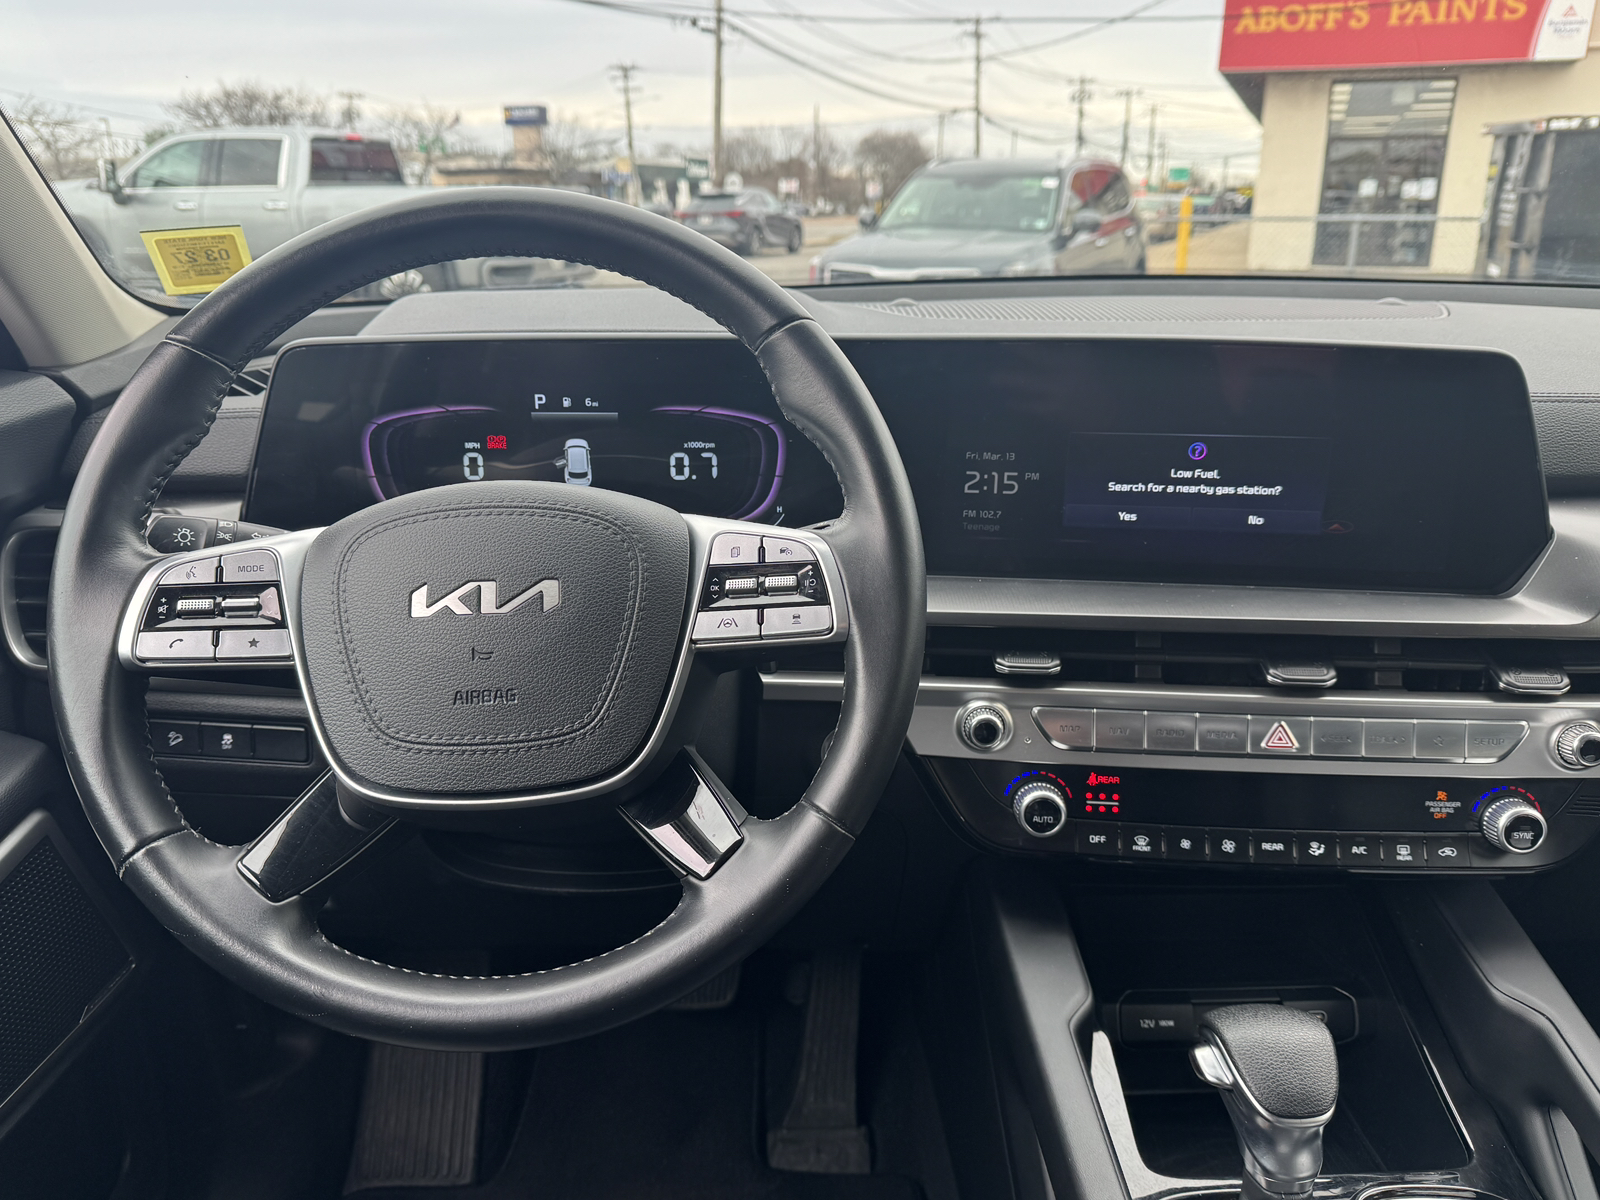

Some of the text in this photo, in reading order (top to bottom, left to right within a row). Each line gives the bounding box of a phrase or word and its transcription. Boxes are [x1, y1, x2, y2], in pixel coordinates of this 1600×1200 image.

[1387, 0, 1528, 27] PAINTS
[534, 394, 546, 409] P
[463, 452, 485, 481] 0
[670, 452, 718, 480] 0.7
[1171, 469, 1193, 478] Low
[964, 471, 1018, 494] 2:15
[1108, 482, 1283, 496] Search for a nearby gas station?
[963, 510, 976, 518] FM
[1118, 512, 1264, 525] Yes No
[963, 522, 1000, 532] Teenage
[237, 564, 265, 573] MODE
[410, 579, 561, 618] KIA
[453, 688, 518, 705] AIRBAG
[1059, 725, 1081, 733] MAP
[1109, 727, 1129, 735] NAV
[1156, 728, 1185, 737] RADIO
[1207, 730, 1237, 739] MEDIA
[1474, 738, 1505, 746] SETUP
[1097, 775, 1120, 784] REAR
[1089, 835, 1106, 844] OFF
[1513, 832, 1534, 840] SYNC
[1262, 842, 1284, 851] REAR
[1351, 846, 1368, 855] A/C
[1140, 1019, 1155, 1028] 12V
